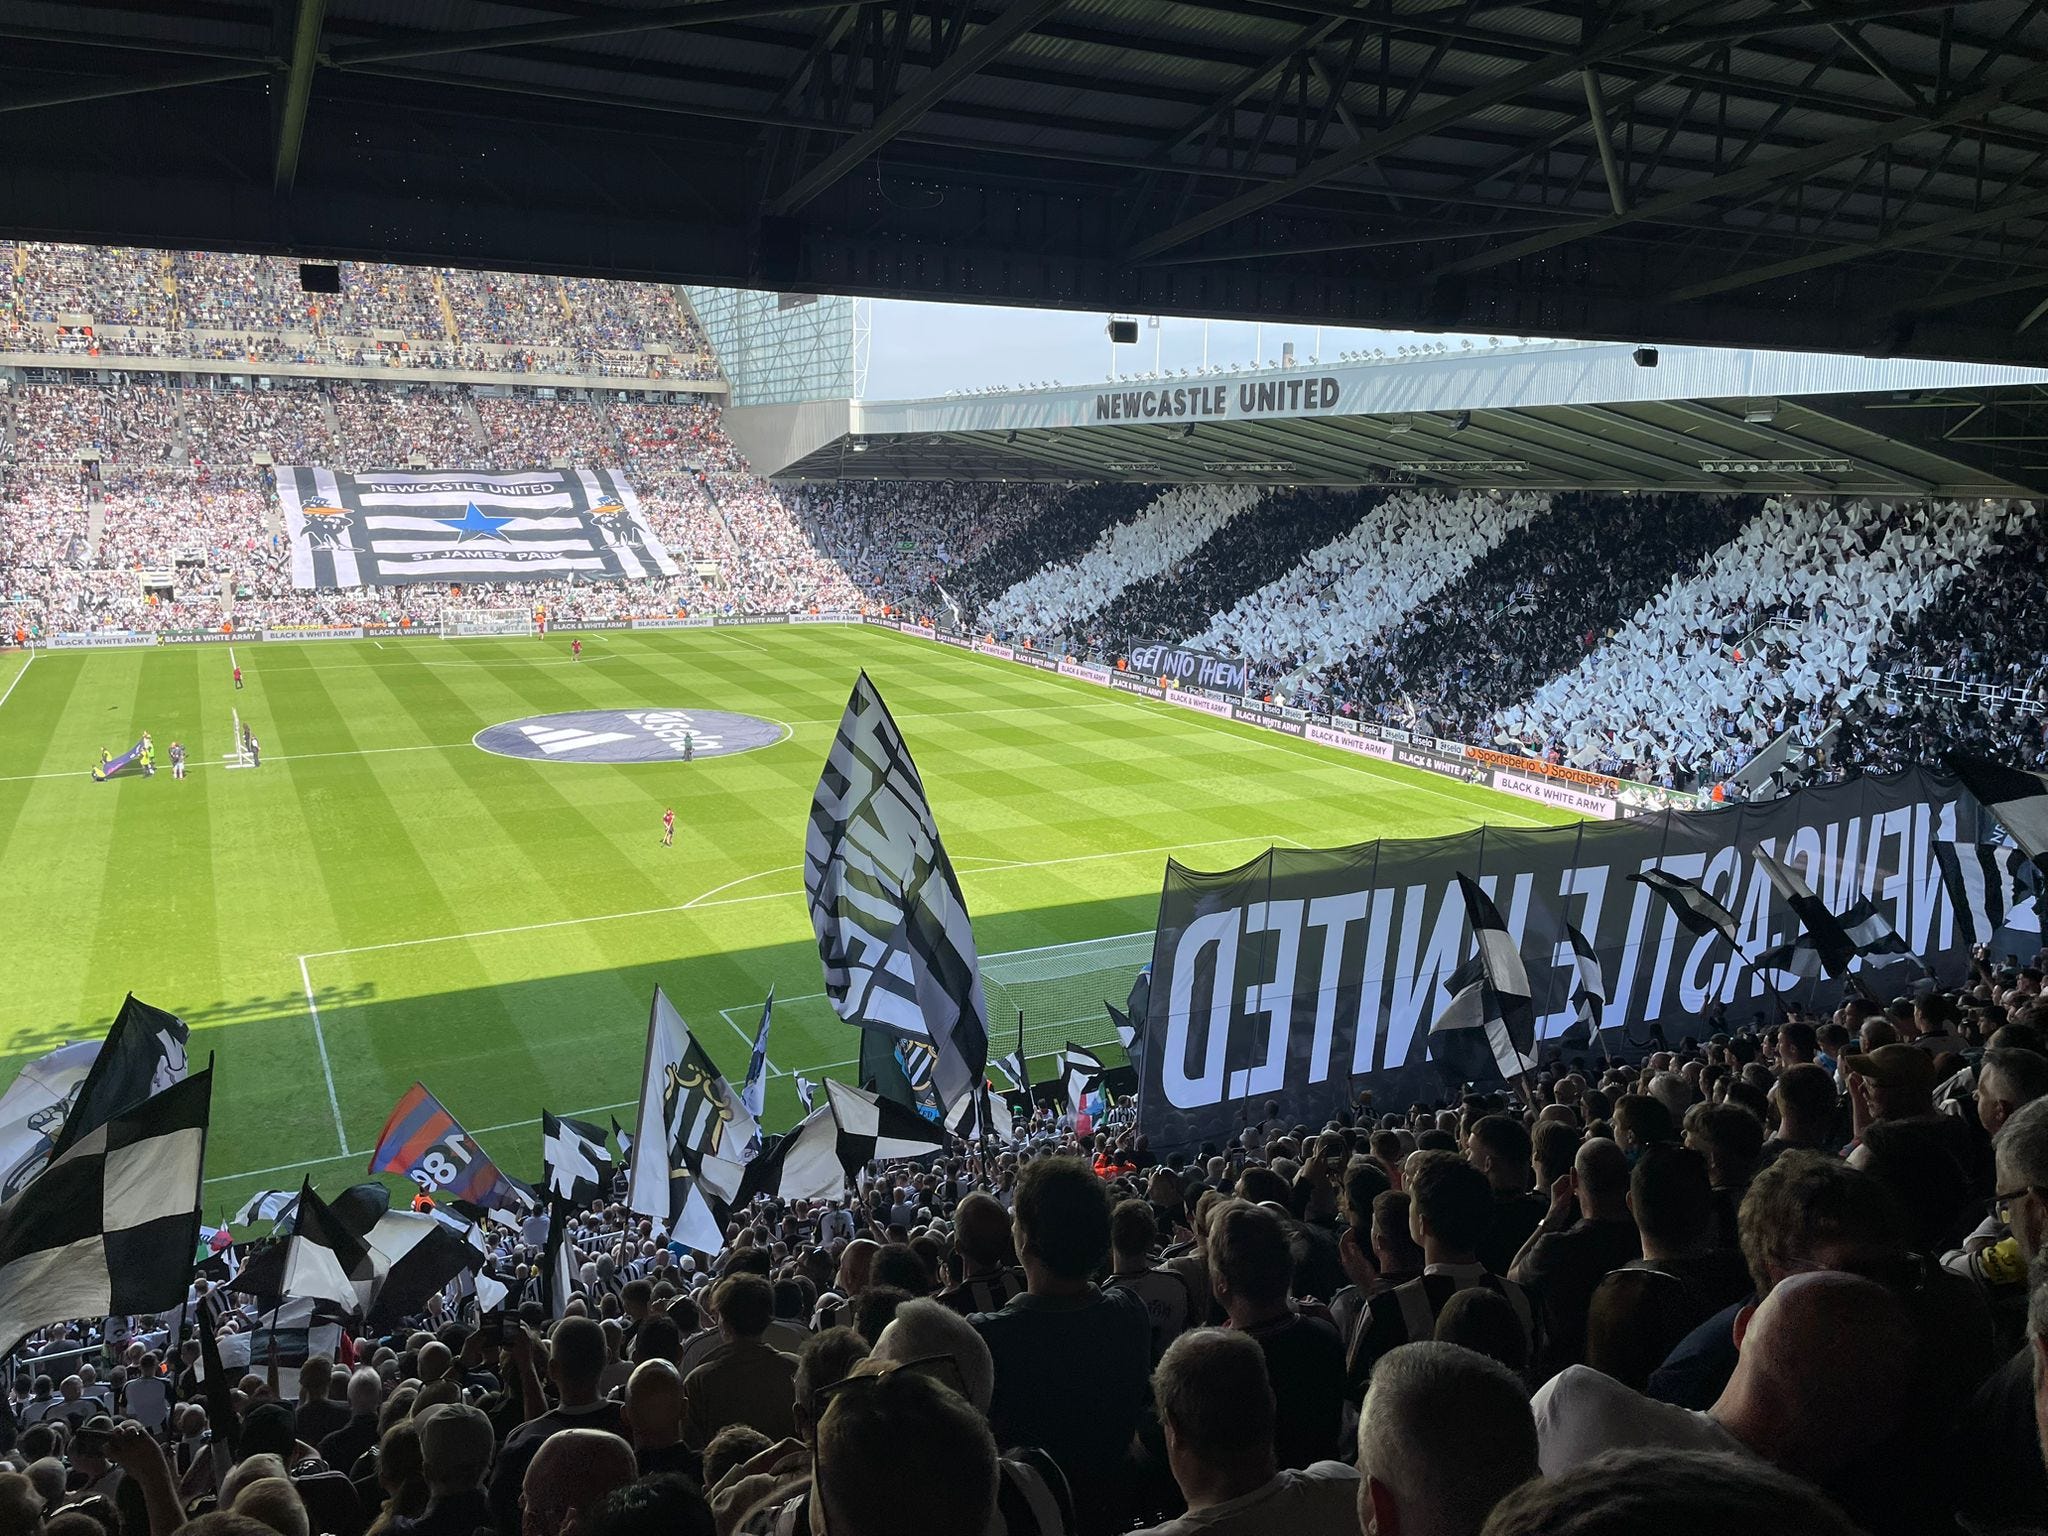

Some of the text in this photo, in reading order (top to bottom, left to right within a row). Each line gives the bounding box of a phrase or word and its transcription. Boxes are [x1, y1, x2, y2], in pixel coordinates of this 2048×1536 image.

[1096, 377, 1340, 420] NEWCASTLE UNITED
[371, 482, 555, 495] NEWCASTLE UNITED
[411, 553, 433, 561] ST
[516, 552, 564, 561] PARK
[369, 628, 394, 636] BLACK
[404, 627, 428, 635] WHITE
[553, 622, 576, 630] BLACK
[86, 638, 92, 646] &
[94, 637, 123, 646] WHITE
[125, 637, 151, 645] ARMY
[165, 633, 257, 643] BLACK & WHITE ARMY
[270, 631, 297, 639] BLACK
[306, 631, 332, 639] WHITE
[333, 629, 356, 637] ARMY
[1062, 665, 1075, 674] BLACK
[1131, 644, 1244, 691] GET INTO THEM
[1112, 679, 1163, 697] BLACK & WHITE ARMY
[1170, 693, 1227, 714] BLACK & WHITE ARMY
[1236, 709, 1301, 734] BLACK & WHITE ARMY
[1311, 729, 1387, 756] BLACK & WHITE ARMY
[1399, 750, 1488, 782] BLACK & WHITE ARY
[1501, 778, 1607, 813] BLACK & WHITE ARMY
